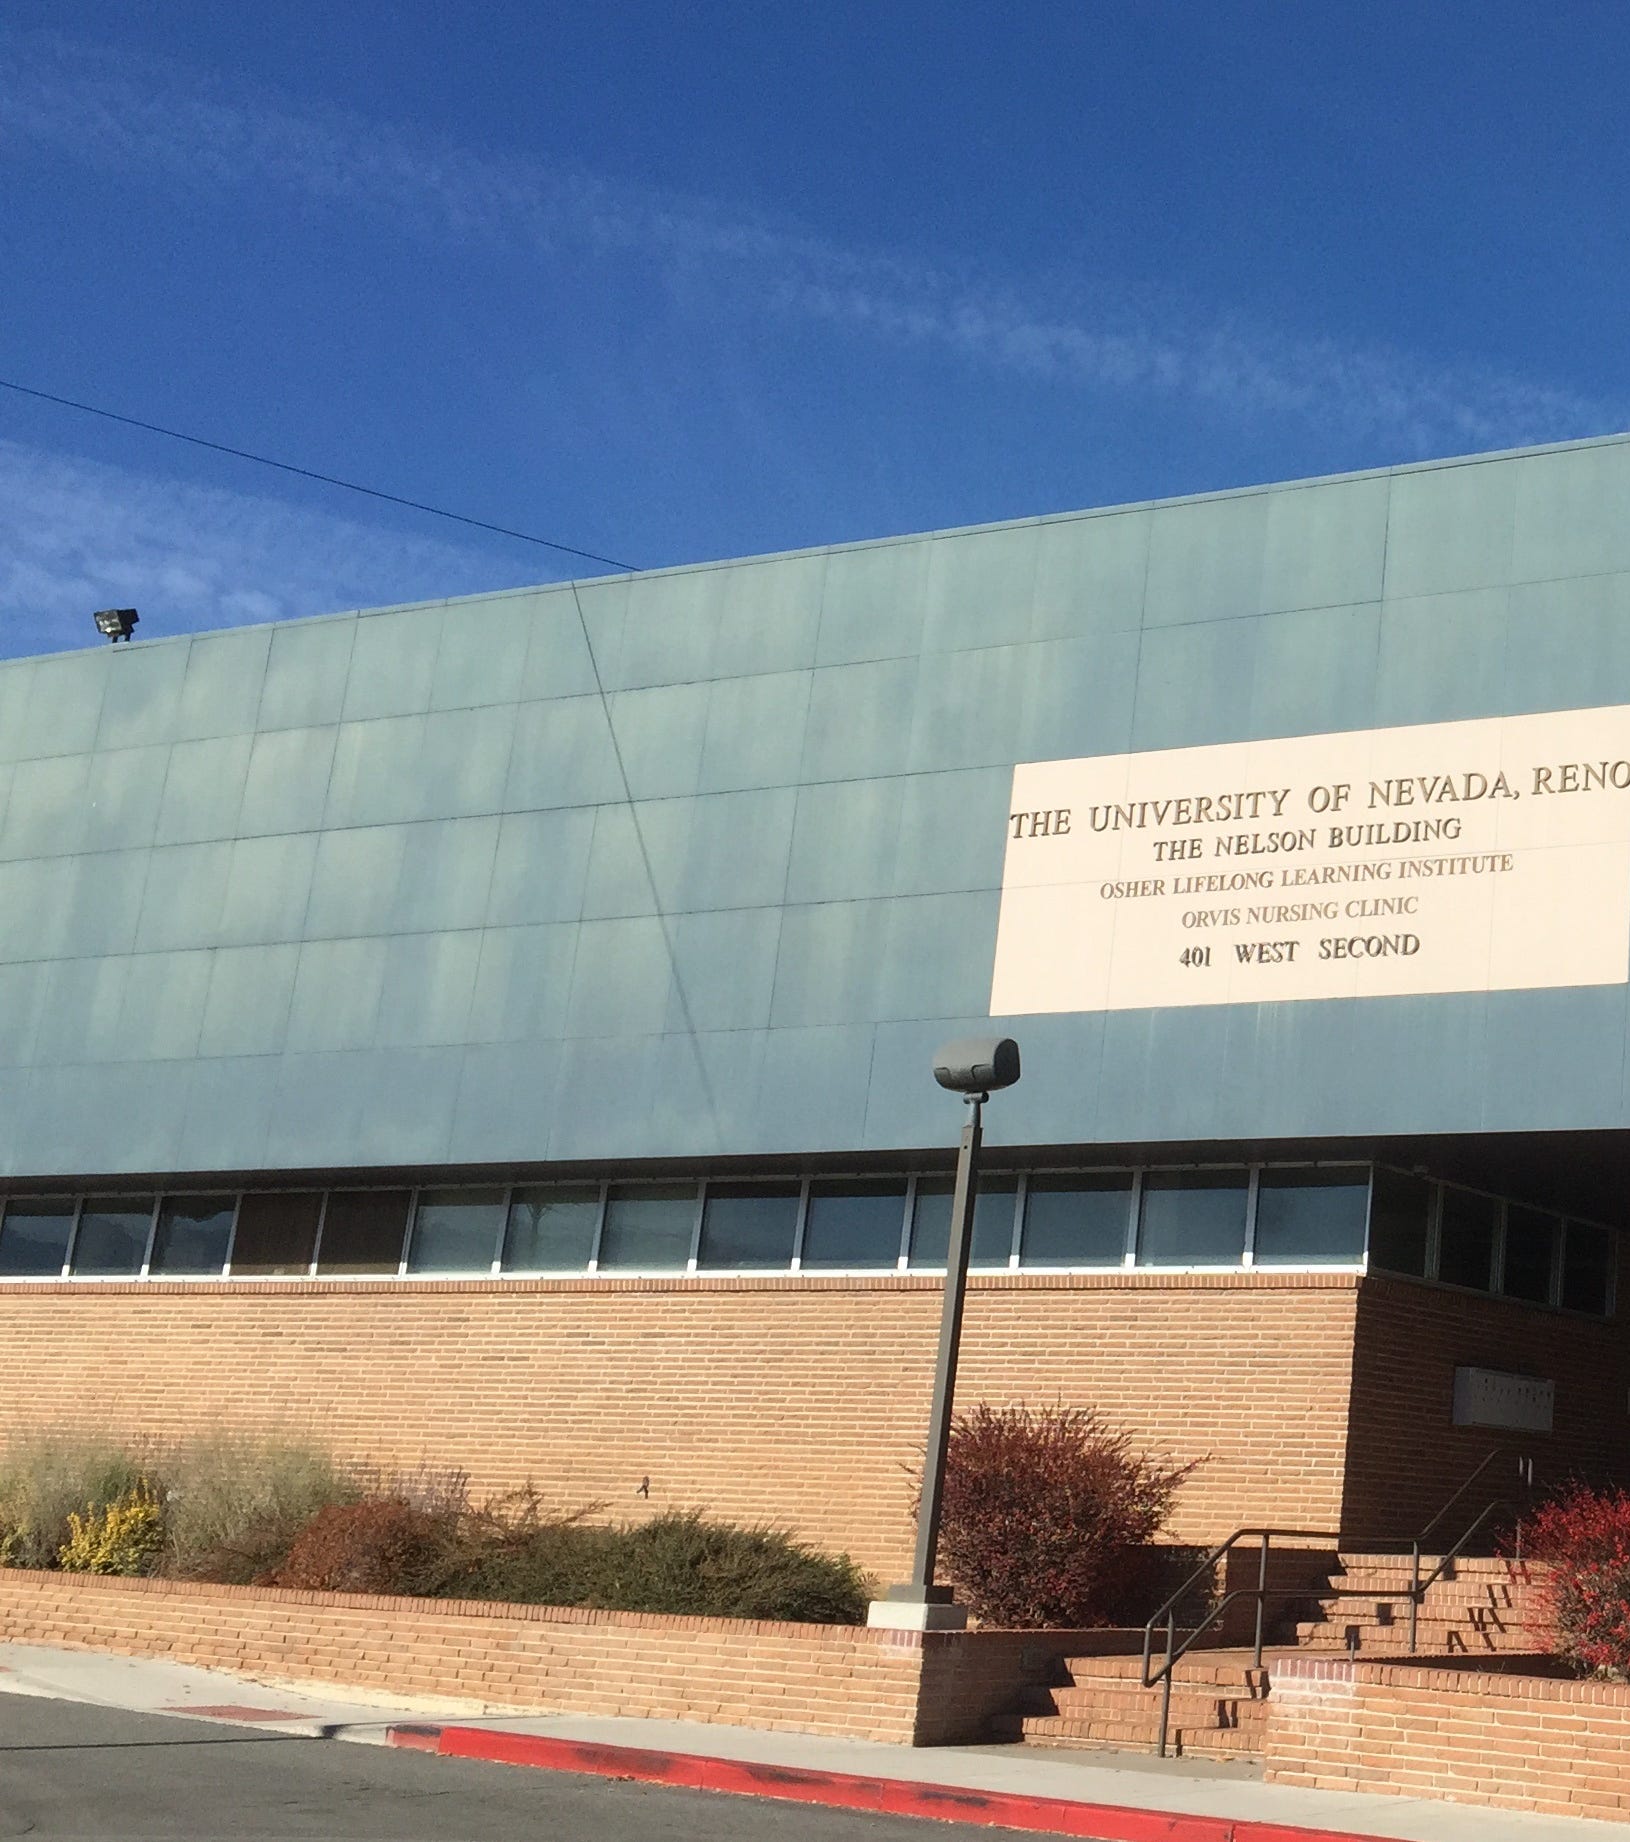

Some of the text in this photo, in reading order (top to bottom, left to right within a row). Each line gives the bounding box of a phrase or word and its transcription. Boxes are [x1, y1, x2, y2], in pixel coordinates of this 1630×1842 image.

[1009, 808, 1071, 839] THE
[1088, 788, 1291, 832] UNIVERSITY
[1307, 783, 1351, 813] OF
[1367, 770, 1520, 808] NEVADA,
[1153, 817, 1461, 862] THE NELSON BUILDING
[1099, 853, 1514, 900] OSHER LIFELONG LEARNING INSTITUTE
[1181, 896, 1419, 929] ORVIS NURSING CLINIC
[1179, 933, 1420, 968] 401 WEST SECOND
